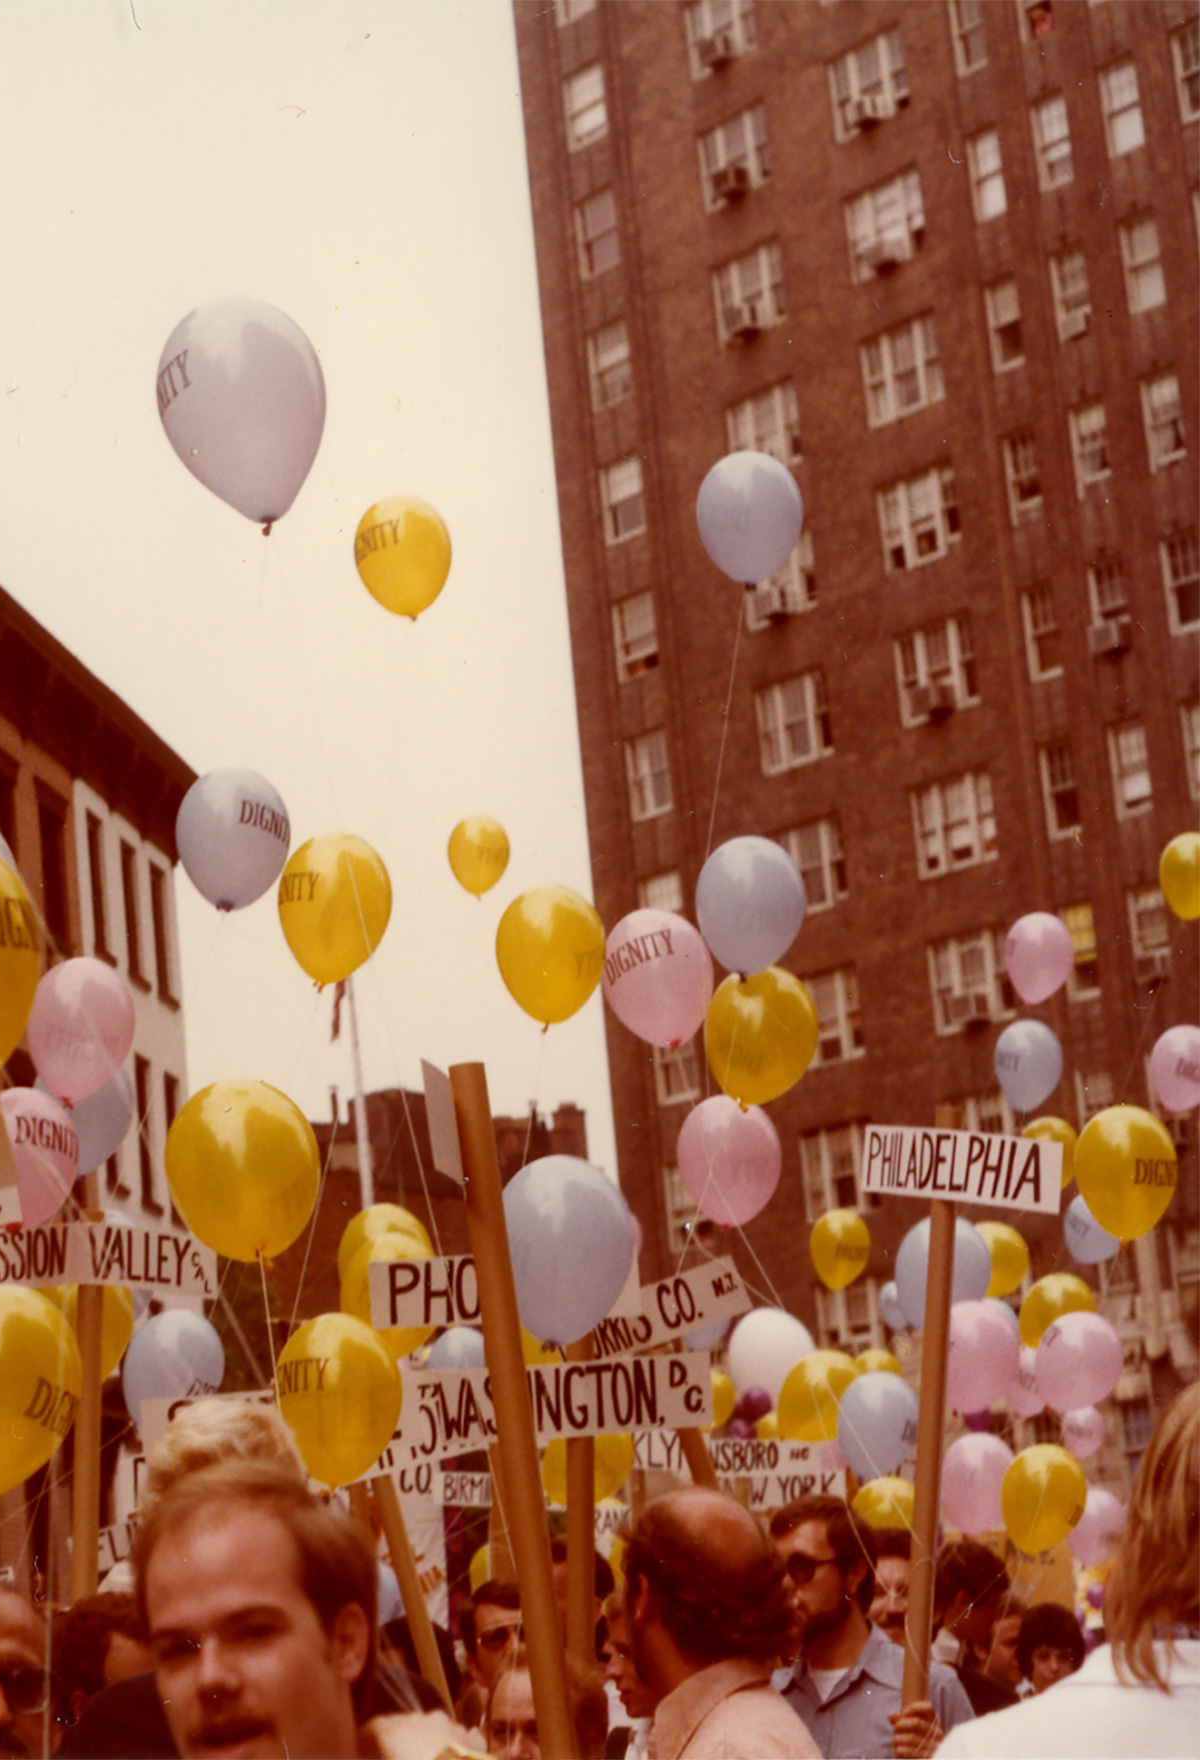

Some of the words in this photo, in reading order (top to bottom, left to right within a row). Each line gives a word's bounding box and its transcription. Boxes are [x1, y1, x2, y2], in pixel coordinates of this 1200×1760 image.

[606, 930, 674, 986] DIGNITY
[866, 1133, 1042, 1203] PHILADELPHIA
[88, 1225, 192, 1287] VALLEY
[656, 1277, 704, 1329] CO.
